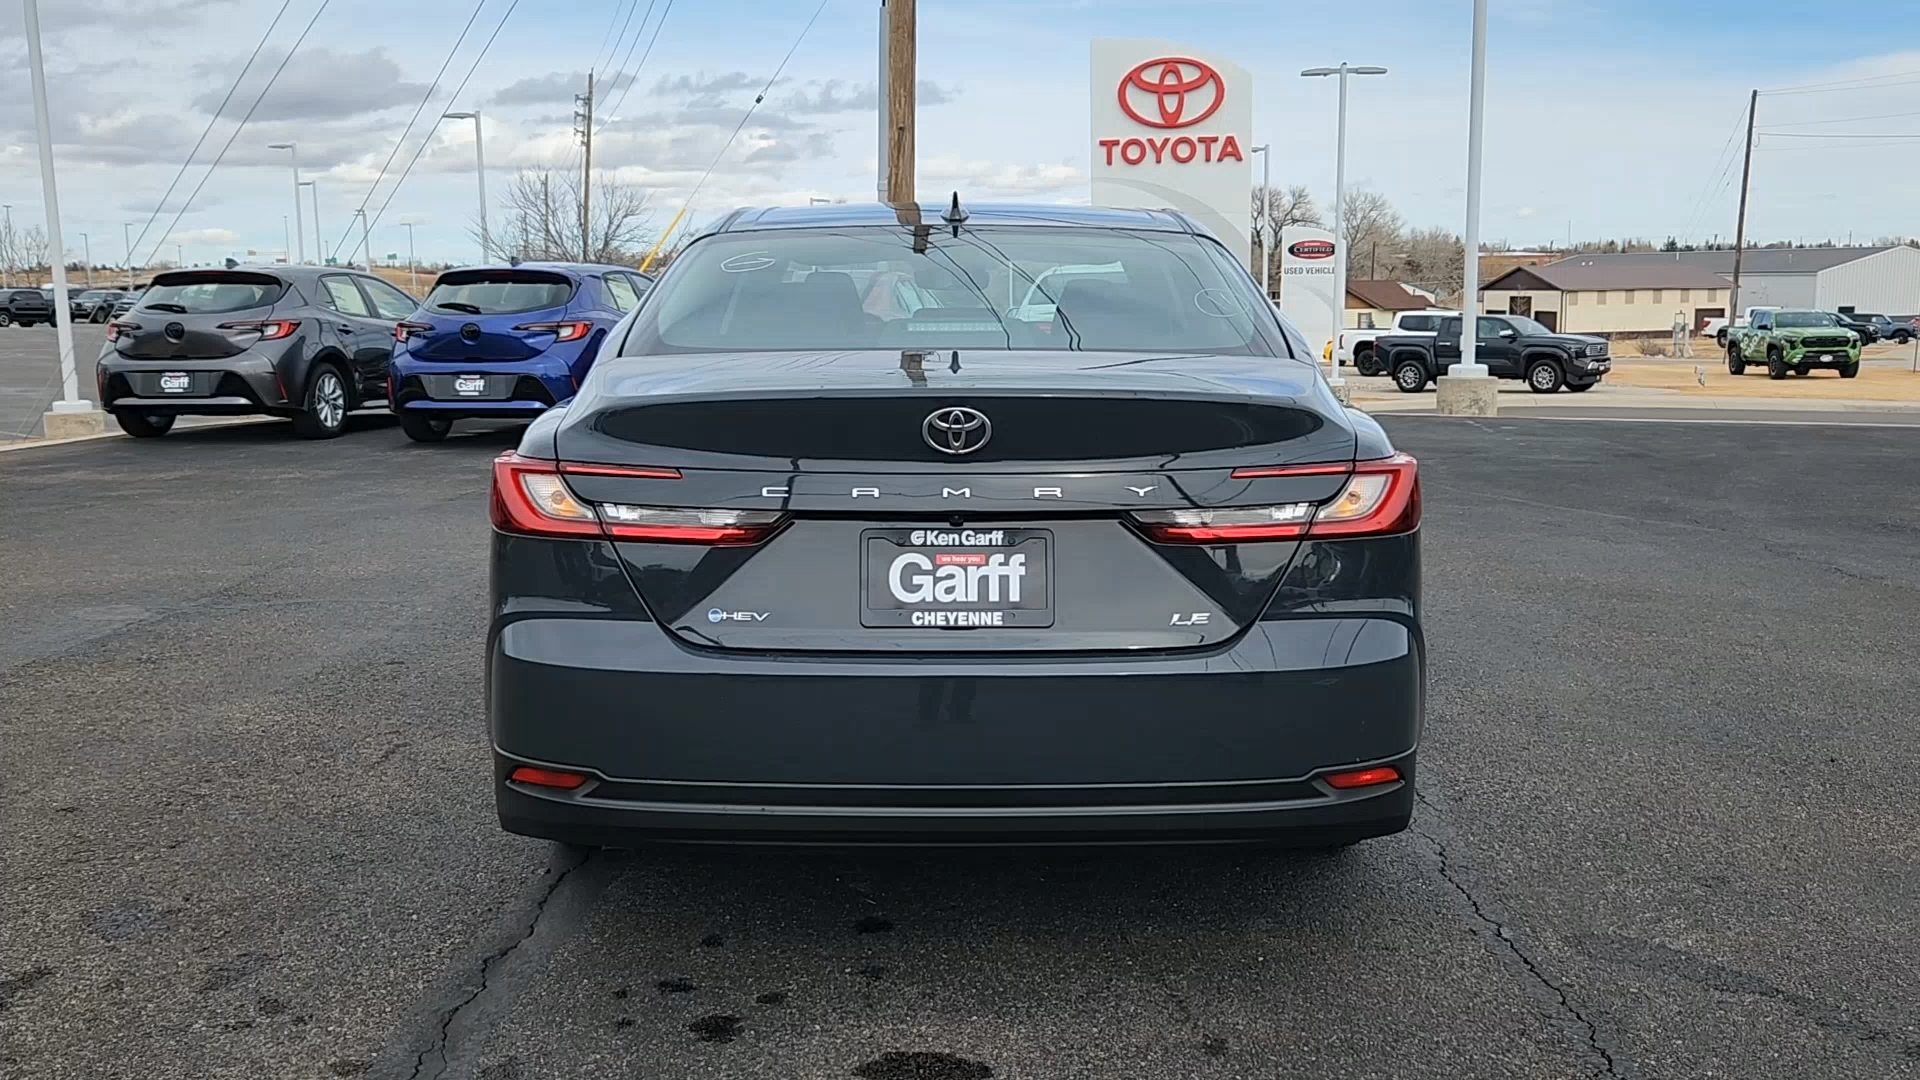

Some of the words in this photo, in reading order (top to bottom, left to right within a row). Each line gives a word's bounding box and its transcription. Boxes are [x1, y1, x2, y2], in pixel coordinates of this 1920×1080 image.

[1099, 136, 1243, 166] TOYOTA
[1284, 267, 1303, 275] USED
[160, 376, 189, 388] Garff
[455, 379, 485, 391] Garff
[762, 486, 1159, 498] CAMRY
[926, 530, 959, 546] Ken
[961, 530, 1004, 546] Garff
[952, 555, 967, 563] hear
[967, 556, 981, 564] you
[888, 552, 1026, 603] Garff
[911, 612, 1003, 625] CHEYENNE
[1169, 612, 1211, 626] LE
